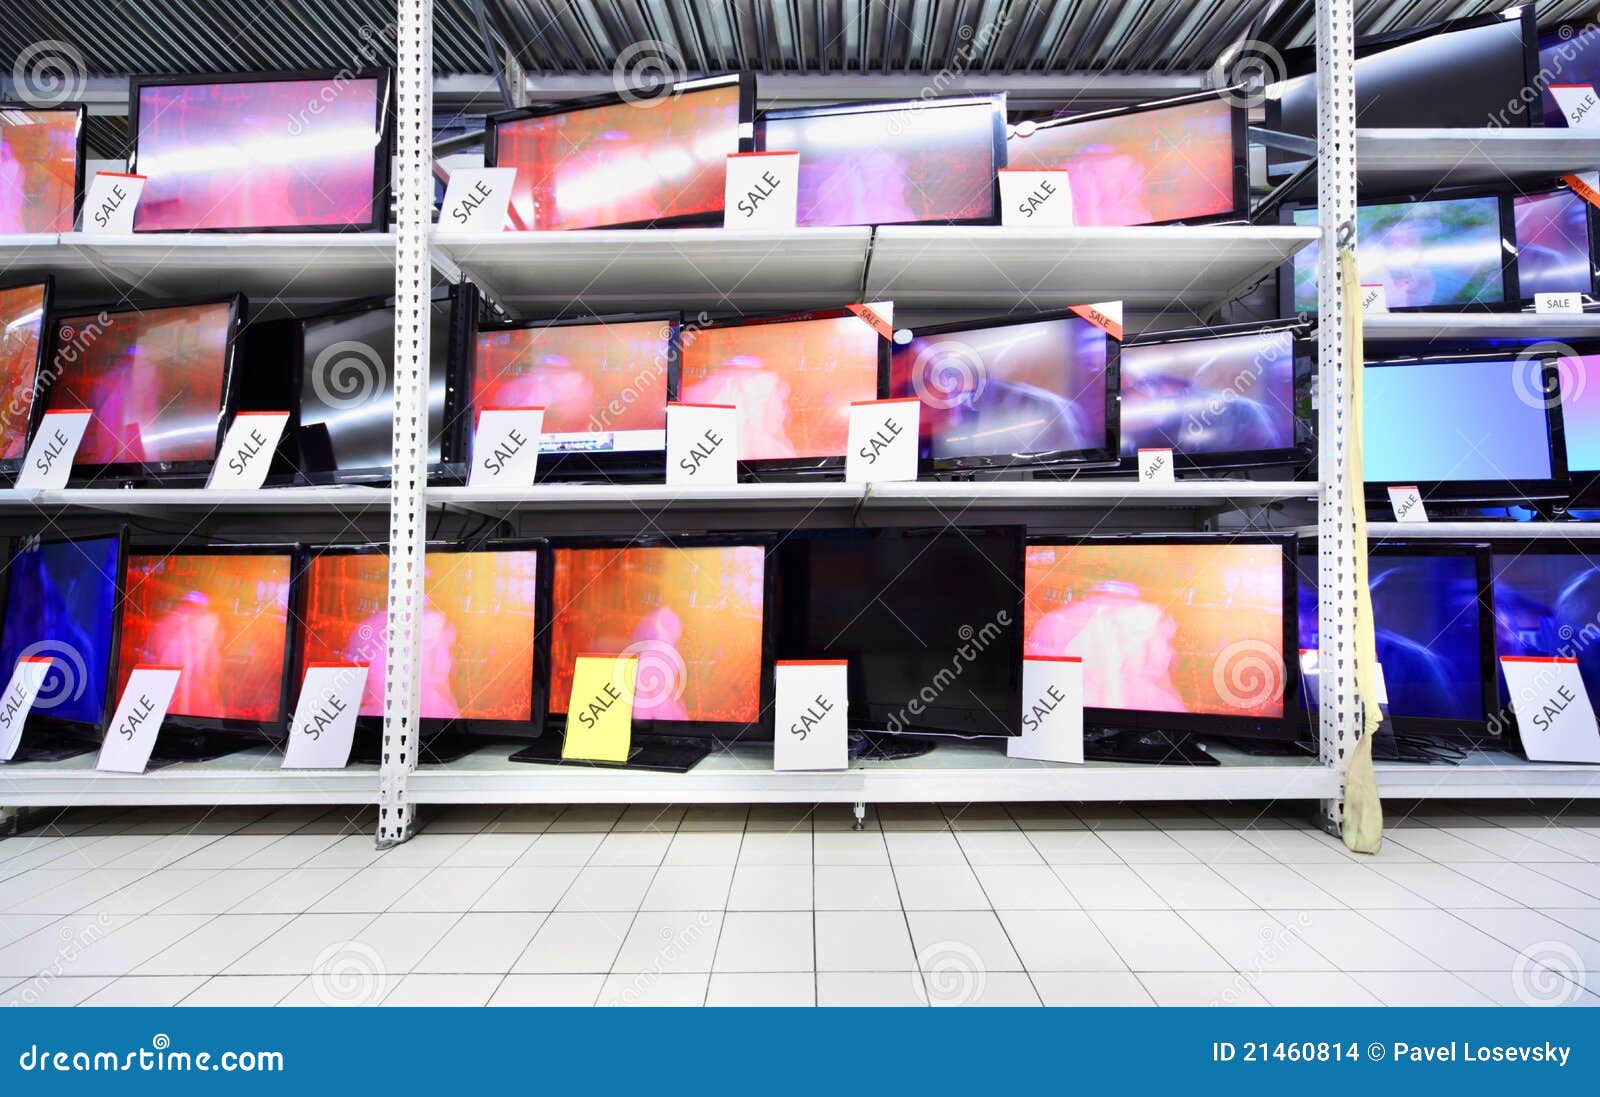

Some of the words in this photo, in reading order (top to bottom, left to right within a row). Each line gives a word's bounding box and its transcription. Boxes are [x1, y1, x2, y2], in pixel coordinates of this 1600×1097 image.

[1570, 93, 1597, 123] SALE
[94, 184, 127, 228] SALE
[452, 179, 492, 225] SALE
[737, 170, 781, 218] SALE
[1018, 180, 1057, 218] SALE
[1572, 179, 1595, 199] SALE
[859, 309, 881, 329] SALE
[1088, 309, 1110, 329] SALE
[1362, 290, 1378, 309] SALE
[1546, 298, 1570, 309] SALE
[36, 429, 69, 475] SALE
[229, 429, 267, 475] SALE
[483, 429, 528, 475] SALE
[680, 429, 723, 475] SALE
[859, 417, 904, 464] SALE
[1144, 456, 1166, 480] SALE
[1397, 493, 1418, 517] SALE
[0, 681, 28, 729] SALE
[119, 694, 155, 741] SALE
[304, 694, 347, 741] SALE
[578, 681, 622, 728] SALE
[791, 694, 834, 740] SALE
[1022, 685, 1065, 730] SALE
[1533, 685, 1576, 731] SALE
